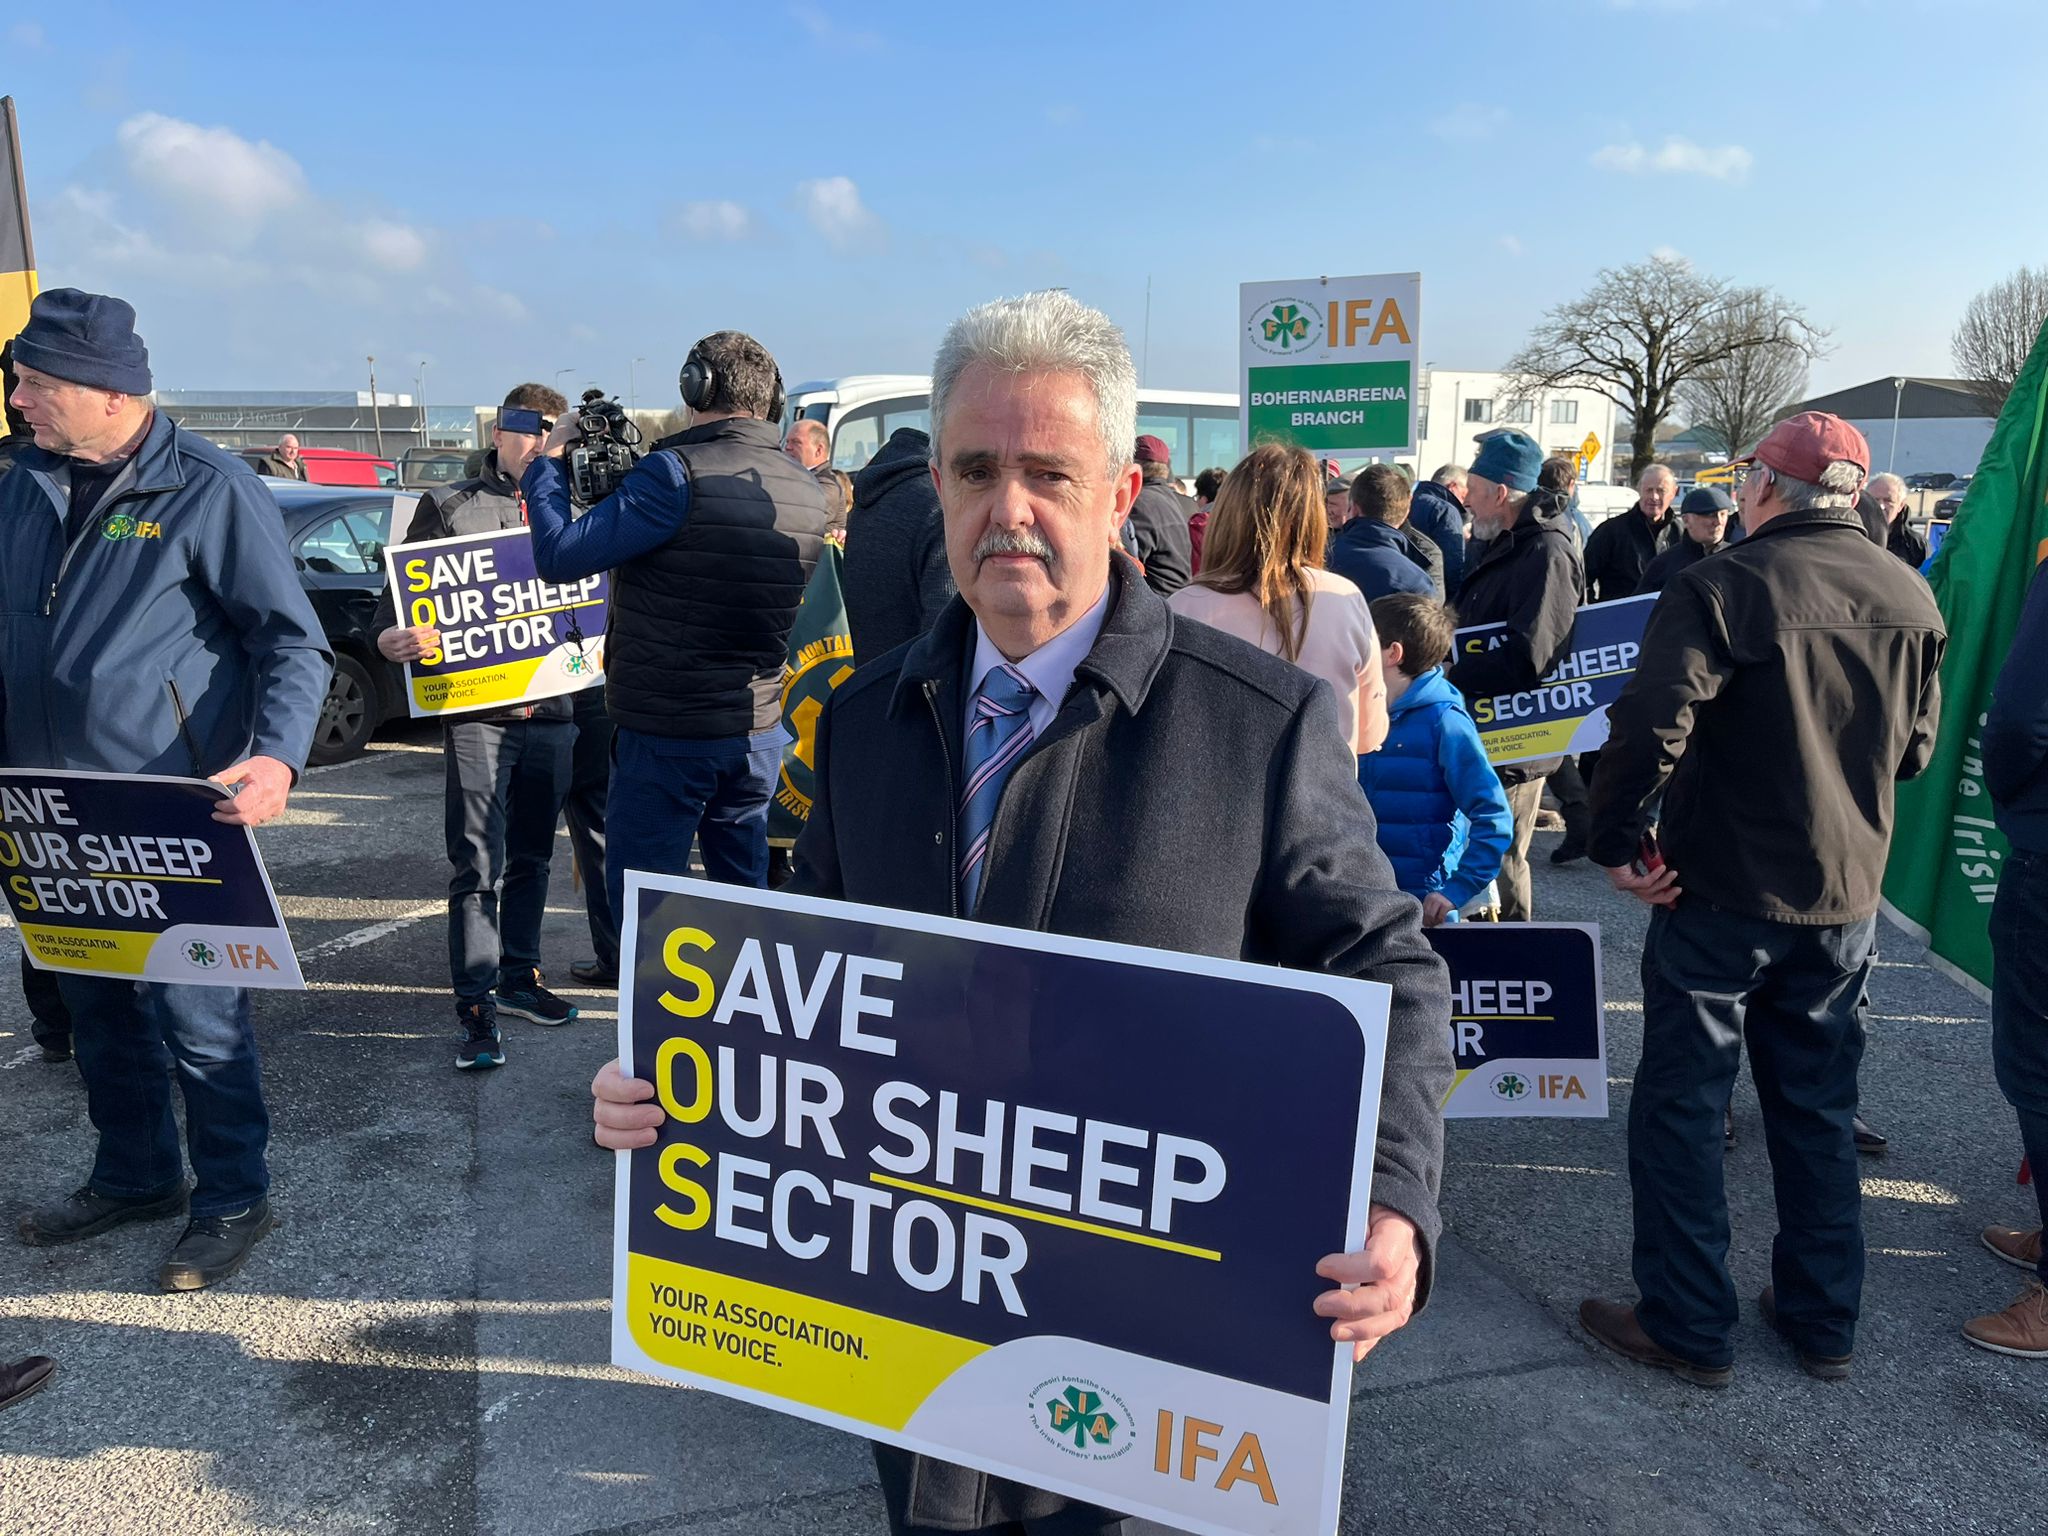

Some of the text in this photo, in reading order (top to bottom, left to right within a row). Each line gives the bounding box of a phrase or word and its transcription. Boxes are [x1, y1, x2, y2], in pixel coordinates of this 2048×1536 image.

[1327, 297, 1412, 347] IFA
[1250, 386, 1407, 406] BOHERNABREENA
[1291, 410, 1364, 426] BRANCH
[135, 520, 161, 539] IFA
[405, 548, 498, 593] SAVE
[411, 588, 488, 628] OUR
[422, 673, 509, 693] YOUR ASSOCIATION.
[424, 687, 479, 703] YOUR VOICE.
[1474, 681, 1595, 724] SECTOR
[1482, 737, 1499, 746] OUR
[0, 786, 79, 826] AVE
[78, 833, 213, 877] SHEEP
[10, 874, 168, 920] SECTOR
[31, 932, 120, 950] YOUR ASSOCIATION.
[36, 945, 61, 957] YOUR
[225, 942, 279, 970] IFA
[657, 926, 904, 1056] SAVE
[1450, 980, 1552, 1014] HEEP
[1538, 1074, 1586, 1099] IFA
[655, 1036, 1227, 1232] OUR SHEEP
[654, 1143, 1028, 1317] SECTOR
[649, 1312, 782, 1367] YOUR VOICE.
[650, 1282, 869, 1360] YOUR ASSOCIATION.
[1100, 1386, 1110, 1396] na
[1030, 1414, 1040, 1430] The
[1039, 1428, 1056, 1446] Irish
[1093, 1442, 1133, 1461] Association
[1154, 1407, 1279, 1506] IFA
